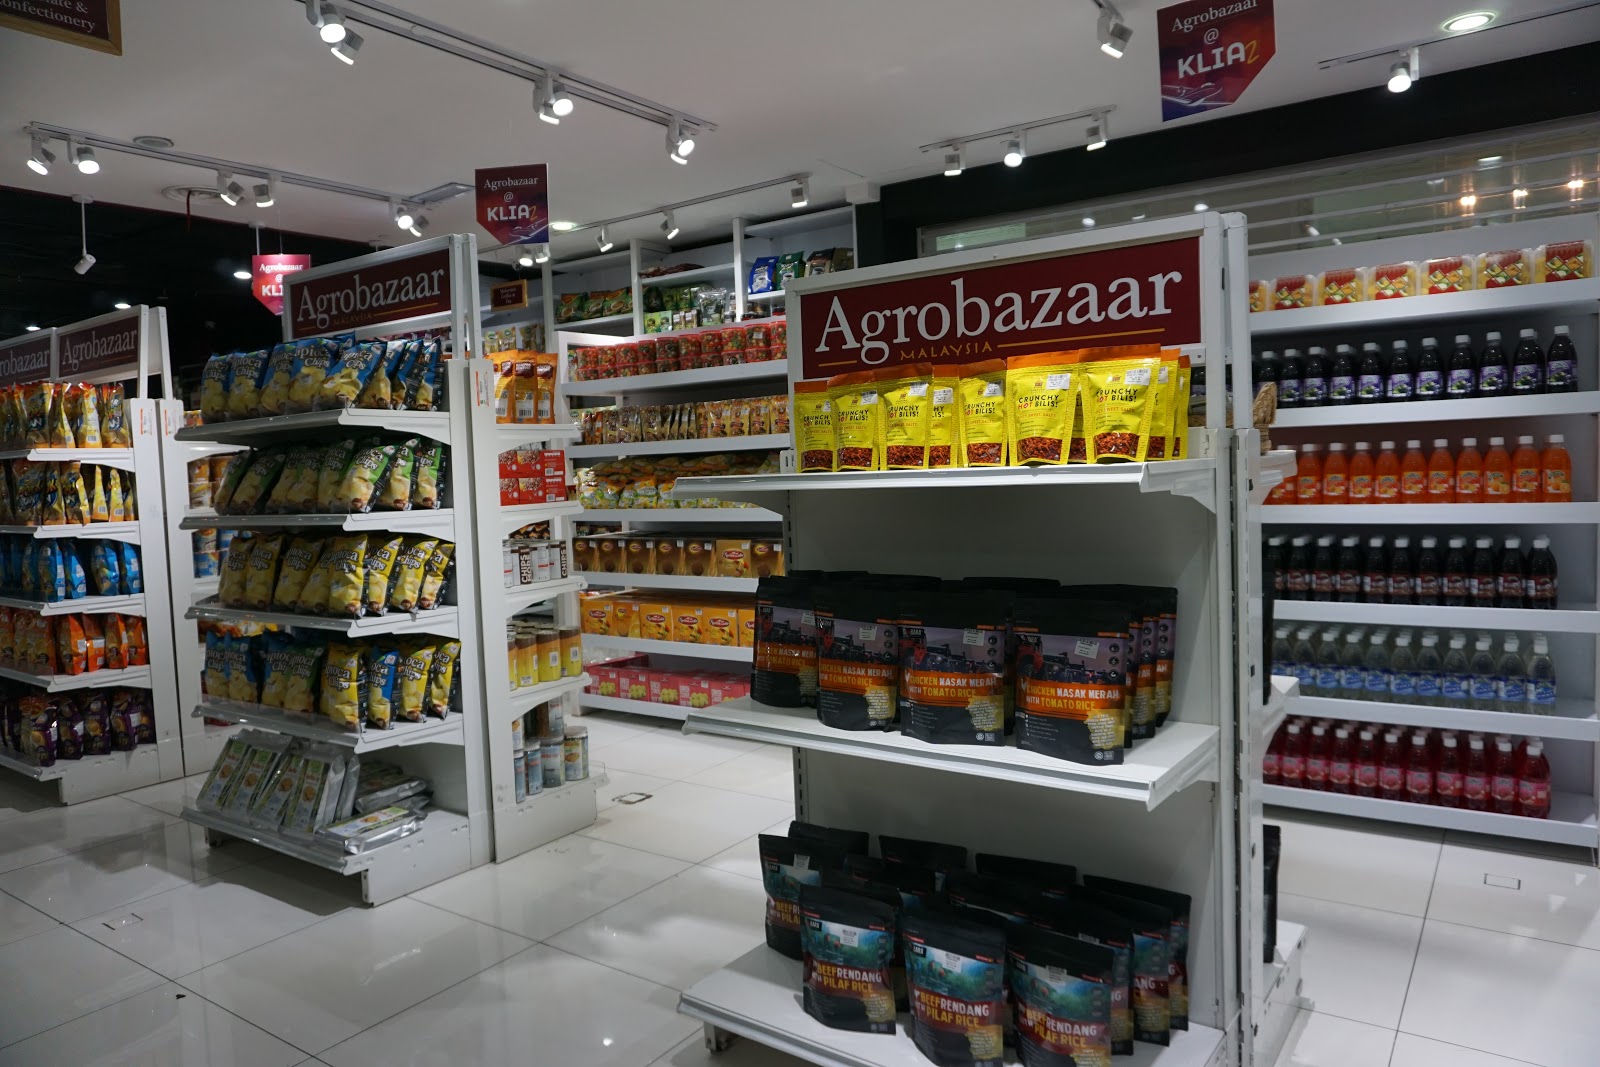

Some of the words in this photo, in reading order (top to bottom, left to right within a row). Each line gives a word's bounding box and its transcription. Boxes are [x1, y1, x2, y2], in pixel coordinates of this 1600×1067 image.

[0, 0, 96, 33] onfectionery
[1171, 0, 1258, 32] Agrobazaar
[1203, 28, 1219, 45] @
[483, 176, 539, 191] Agrobazaar
[503, 191, 514, 203] @
[259, 262, 304, 272] Agrobazaar
[261, 284, 283, 297] KLI
[297, 267, 445, 329] Agrobazaar
[814, 269, 1183, 366] Agrobazaar
[62, 329, 138, 372] Agrobazaar
[900, 340, 993, 361] MALAYSIA
[0, 349, 50, 377] robazaar
[1017, 402, 1033, 410] HOT
[1034, 400, 1059, 408] BILIS!
[1018, 394, 1060, 404] CRUNCHY
[1111, 394, 1137, 403] BILIS!
[889, 405, 920, 413] RUNCHY
[520, 555, 528, 583] CHIPS
[842, 665, 866, 676] MASAK
[867, 668, 893, 678] MERAH
[828, 673, 857, 685] TOMATO
[857, 676, 873, 687] RICE
[910, 675, 938, 686] CHICKEN
[940, 677, 967, 687] MASAK
[969, 677, 997, 688] MERAH
[922, 687, 956, 697] TOMATO
[957, 689, 977, 698] RICE
[1026, 685, 1056, 696] CHICKEN
[1056, 688, 1087, 699] MASAK
[1088, 689, 1120, 699] MERAH
[1025, 695, 1040, 705] WITH
[1040, 698, 1075, 710] TOMATO
[1075, 701, 1096, 710] RICE
[775, 901, 793, 912] BEEF
[781, 912, 801, 924] PILA
[817, 962, 837, 976] BEEF
[837, 967, 882, 983] RENDANG
[823, 976, 851, 991] PILAF
[851, 981, 874, 993] RICE
[920, 990, 940, 1008] BEEF
[940, 997, 990, 1017] RENDANG
[926, 1006, 954, 1024] PILAF
[955, 1013, 980, 1027] RICE
[1025, 1007, 1047, 1024] BEEF
[1046, 1016, 1098, 1036] RENDANG
[1034, 1023, 1058, 1044] PILAF
[1060, 1034, 1088, 1048] RICE
